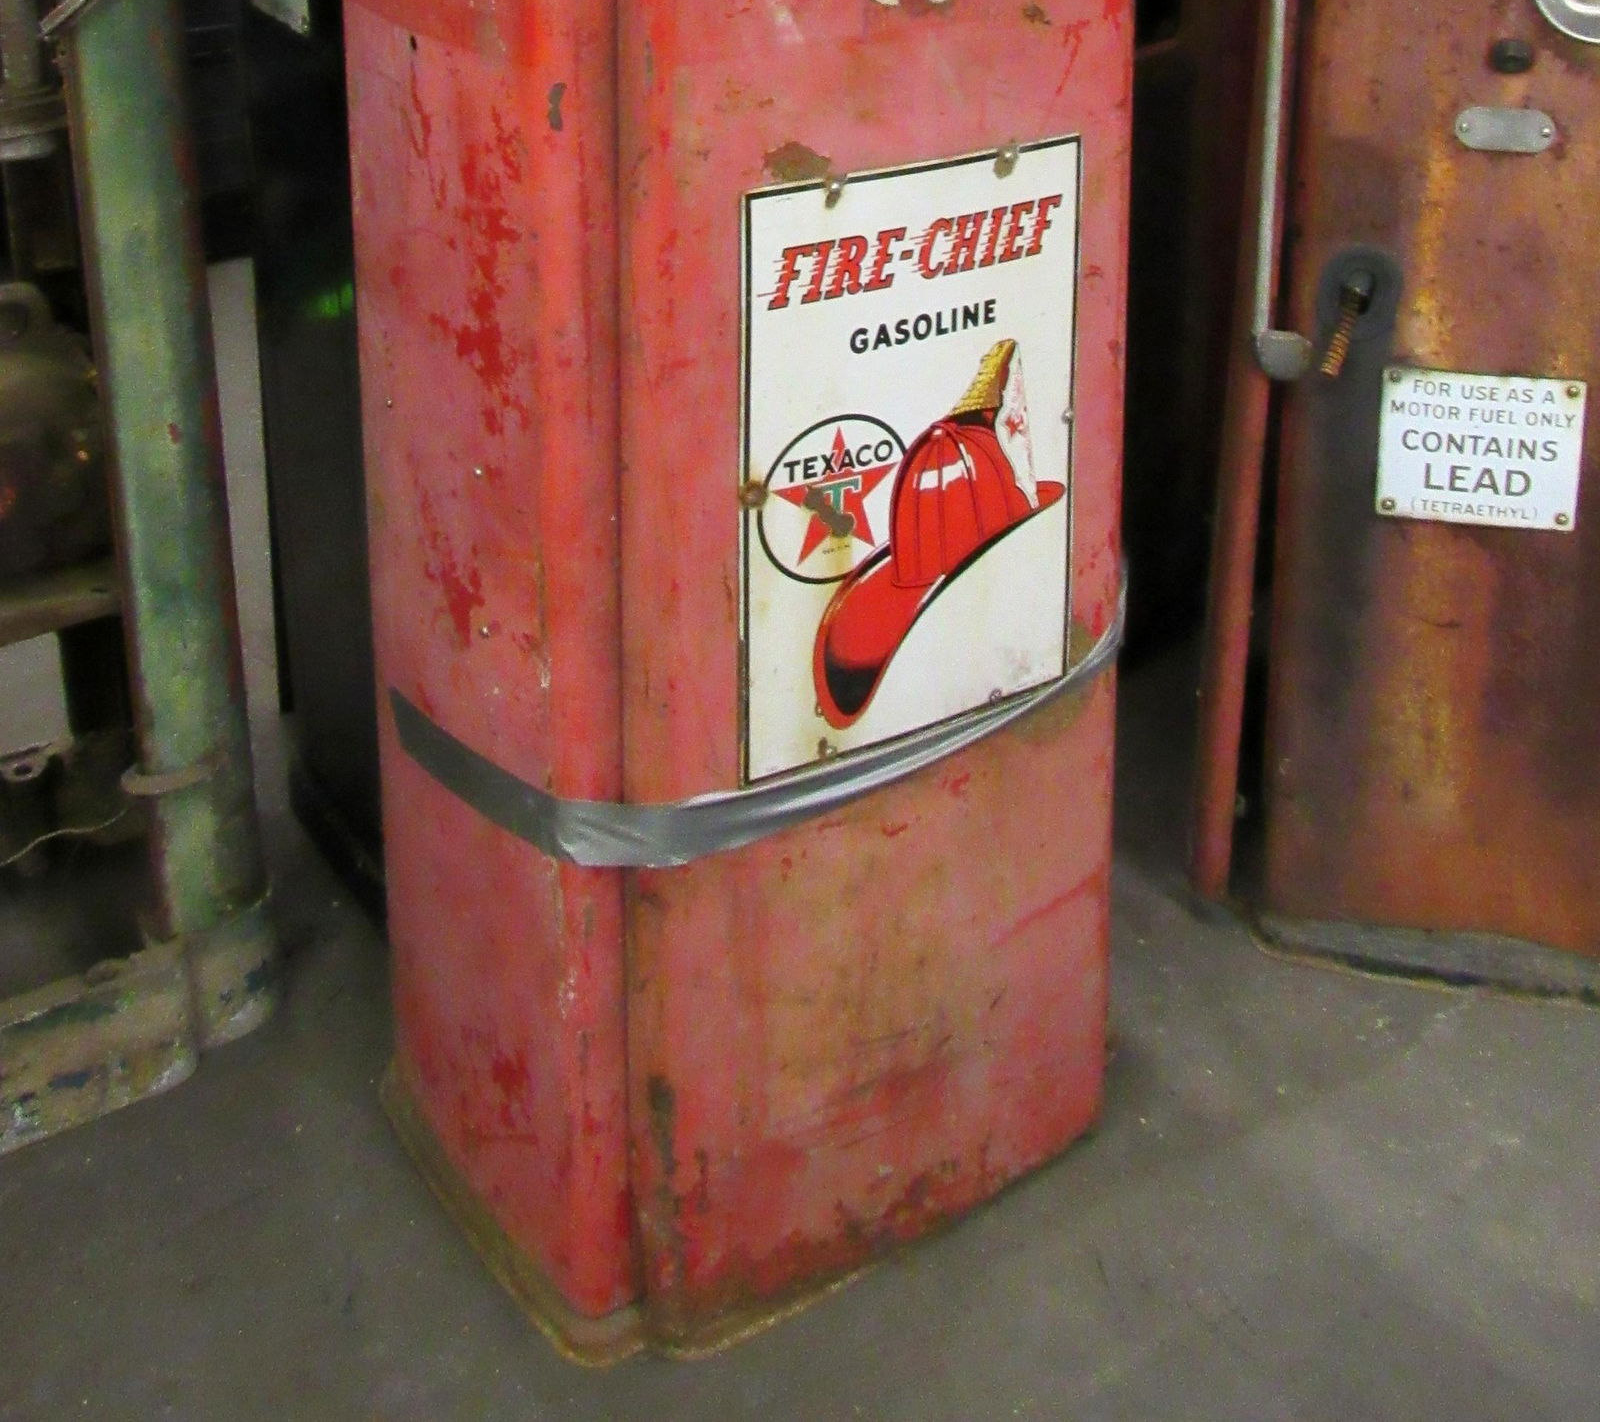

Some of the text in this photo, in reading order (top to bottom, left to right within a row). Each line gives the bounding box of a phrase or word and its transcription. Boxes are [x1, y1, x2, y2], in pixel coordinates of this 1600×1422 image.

[761, 194, 1063, 311] FIRE-CHIEF
[849, 298, 997, 354] GASOLINE
[1413, 379, 1556, 404] FOR USE AS A
[1390, 400, 1576, 428] MOTOR FUEL ONLY
[783, 439, 893, 484] TEXACO
[1401, 429, 1559, 462] CONTAINS
[1423, 463, 1531, 497] LEAD
[1410, 497, 1538, 521] (TETRAETHYL)
